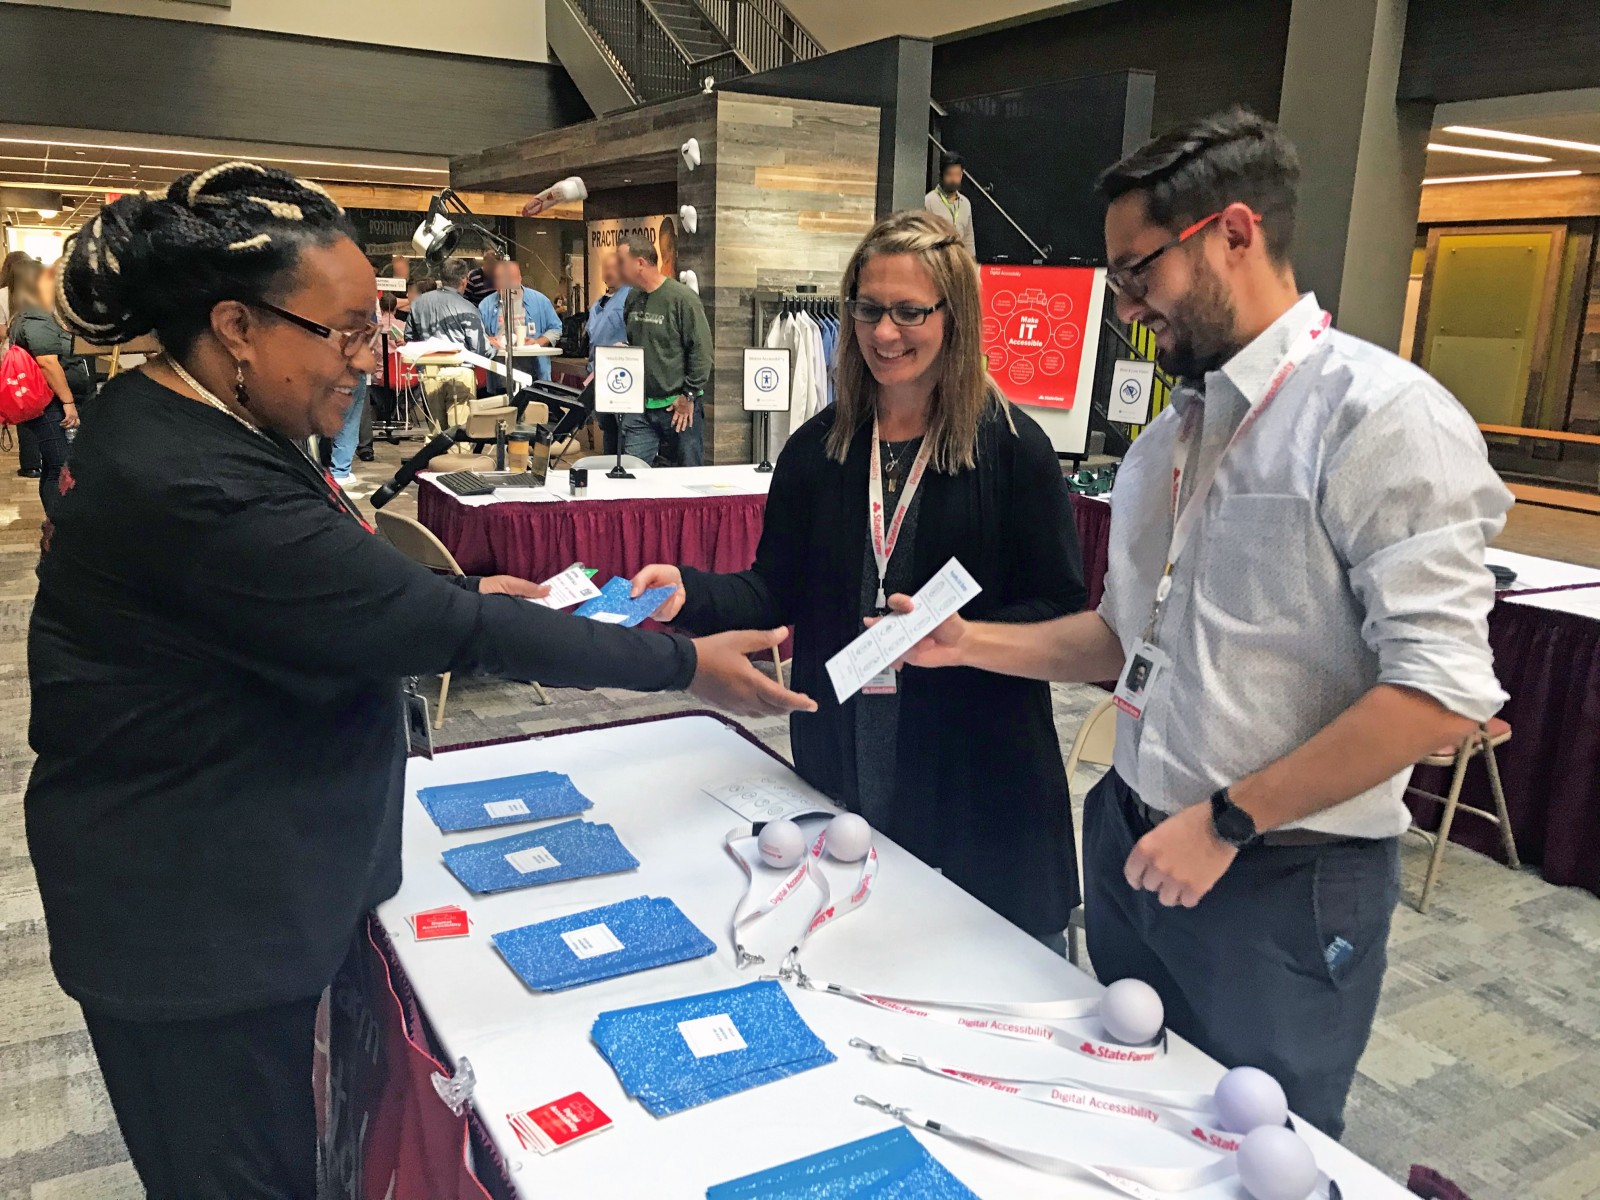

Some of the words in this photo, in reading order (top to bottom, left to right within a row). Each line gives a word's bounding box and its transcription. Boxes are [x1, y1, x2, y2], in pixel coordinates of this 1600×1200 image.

[1019, 323, 1037, 339] IT
[1008, 338, 1043, 347] Accessible
[957, 1017, 988, 1028] Digital
[990, 1020, 1054, 1040] Accessibility
[1051, 1088, 1086, 1103] Digital
[1089, 1097, 1160, 1123] Accessibility
